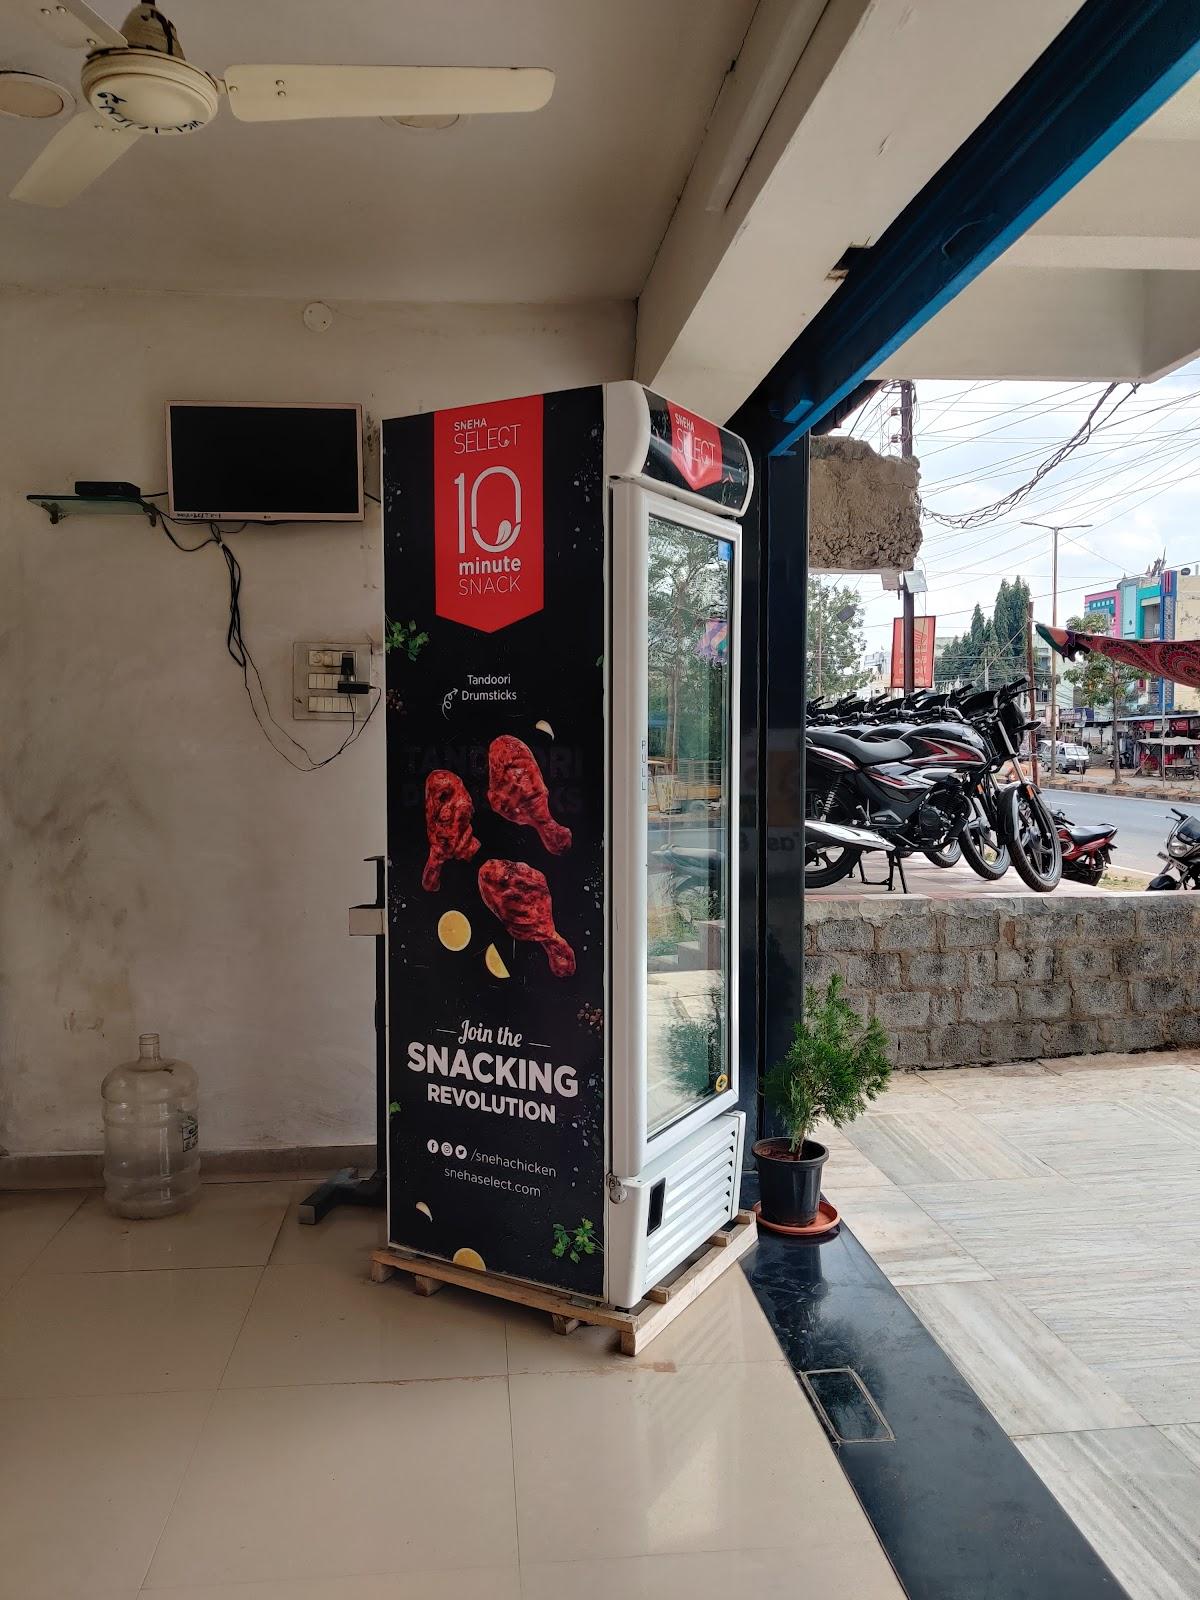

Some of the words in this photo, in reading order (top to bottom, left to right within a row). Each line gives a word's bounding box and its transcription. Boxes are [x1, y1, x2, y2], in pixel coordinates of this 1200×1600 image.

[454, 418, 488, 432] SNEHA
[454, 423, 521, 455] SELECT
[454, 465, 522, 554] 10
[459, 555, 522, 576] minute
[459, 574, 521, 597] SNACK
[467, 674, 511, 685] Tandoori
[461, 689, 517, 701] Drumsticks
[458, 1019, 493, 1045] Join
[497, 1025, 523, 1048] the
[407, 1041, 579, 1099] SNACKING
[427, 1083, 557, 1125] REVOLUTION
[470, 1147, 557, 1178] /snehachicken
[444, 1166, 541, 1198] snehaselect.com
